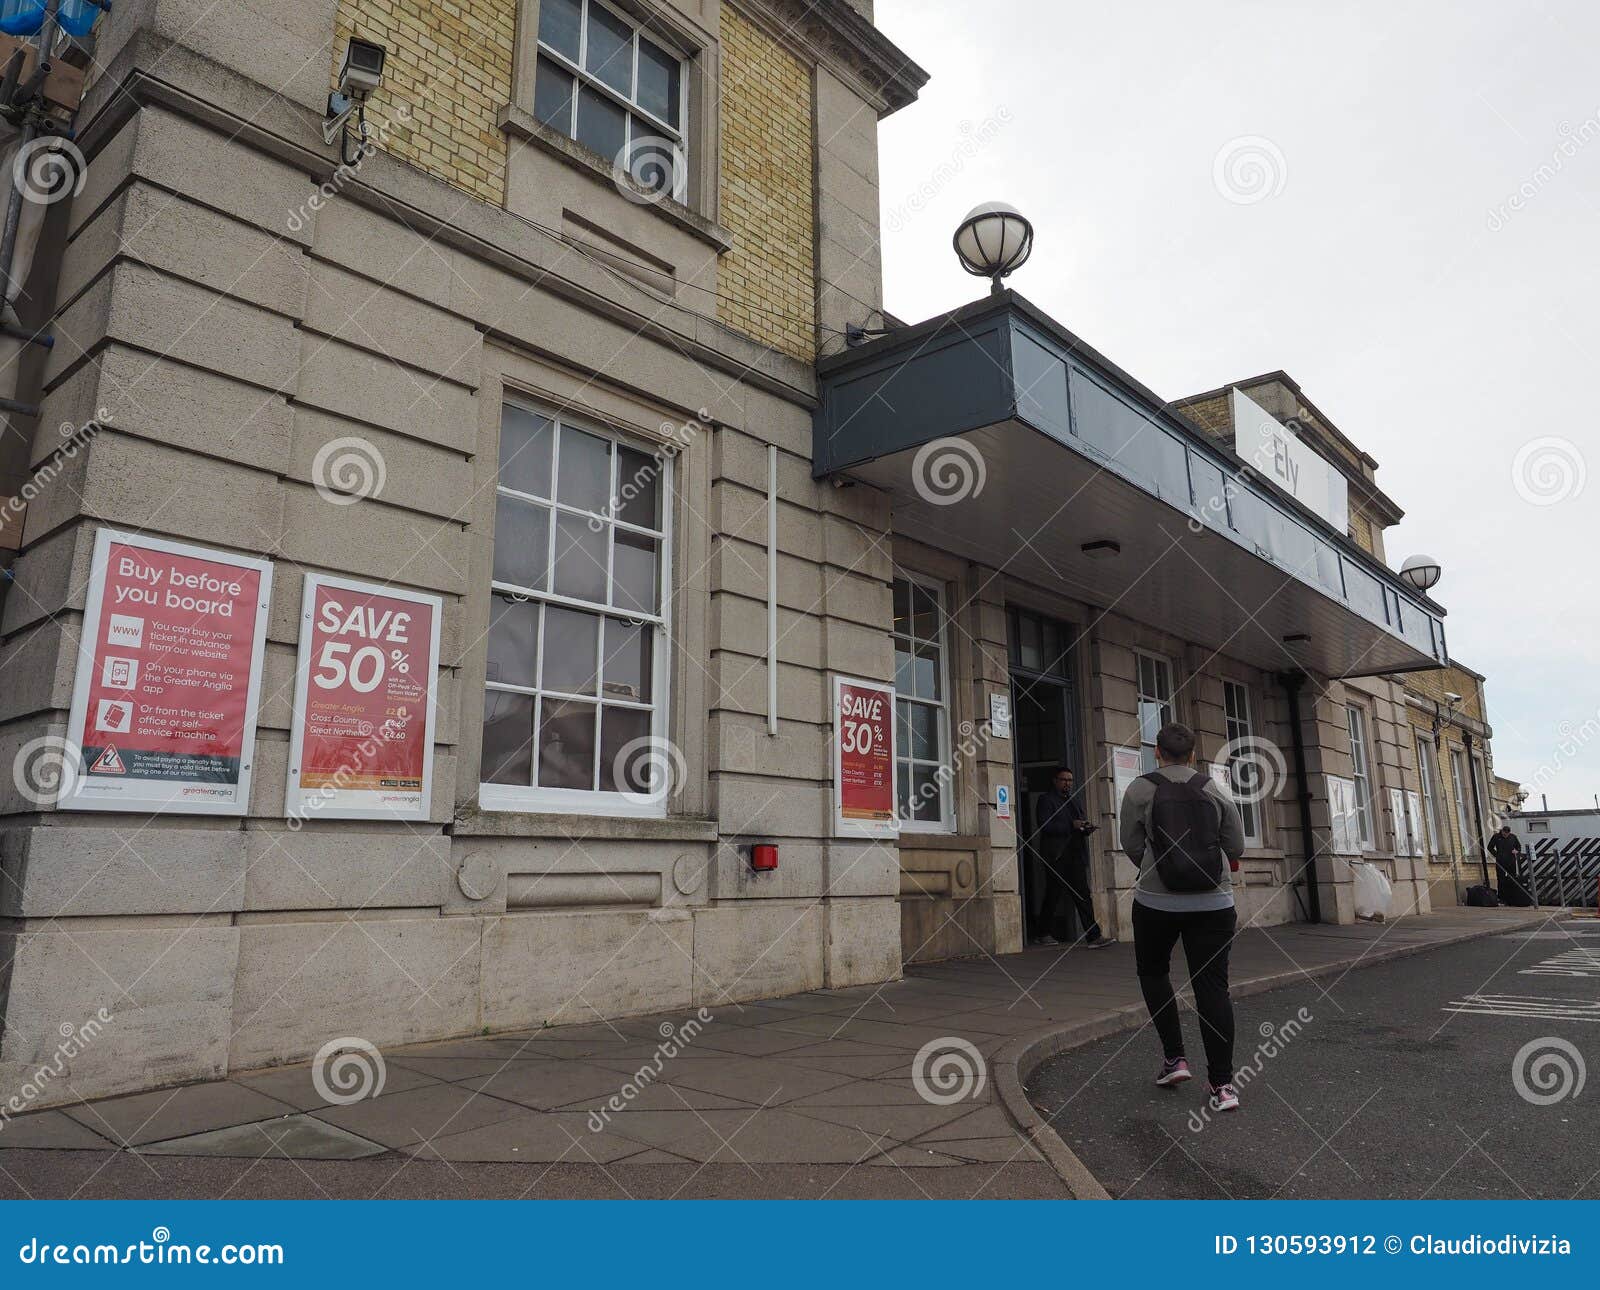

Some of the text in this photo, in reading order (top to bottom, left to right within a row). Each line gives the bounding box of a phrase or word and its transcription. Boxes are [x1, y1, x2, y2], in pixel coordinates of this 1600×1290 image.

[1273, 433, 1298, 495] Ely
[119, 557, 241, 596] Buy before
[115, 584, 233, 616] you board
[113, 624, 140, 636] www
[152, 620, 233, 640] You can buy your
[150, 632, 231, 651] ticket in advance
[149, 643, 228, 660] from our website
[146, 662, 233, 680] On your phone via
[143, 685, 164, 695] app
[144, 674, 232, 691] the Greater Anglia
[140, 704, 225, 721] Or from the ticket
[311, 701, 340, 711] Greater
[342, 704, 365, 714] Anglia
[138, 716, 202, 728] office or self-
[310, 713, 331, 722] Cross
[333, 715, 363, 725] Country
[137, 727, 217, 741] service machine
[310, 725, 331, 734] Great
[182, 787, 233, 796] greateranglia
